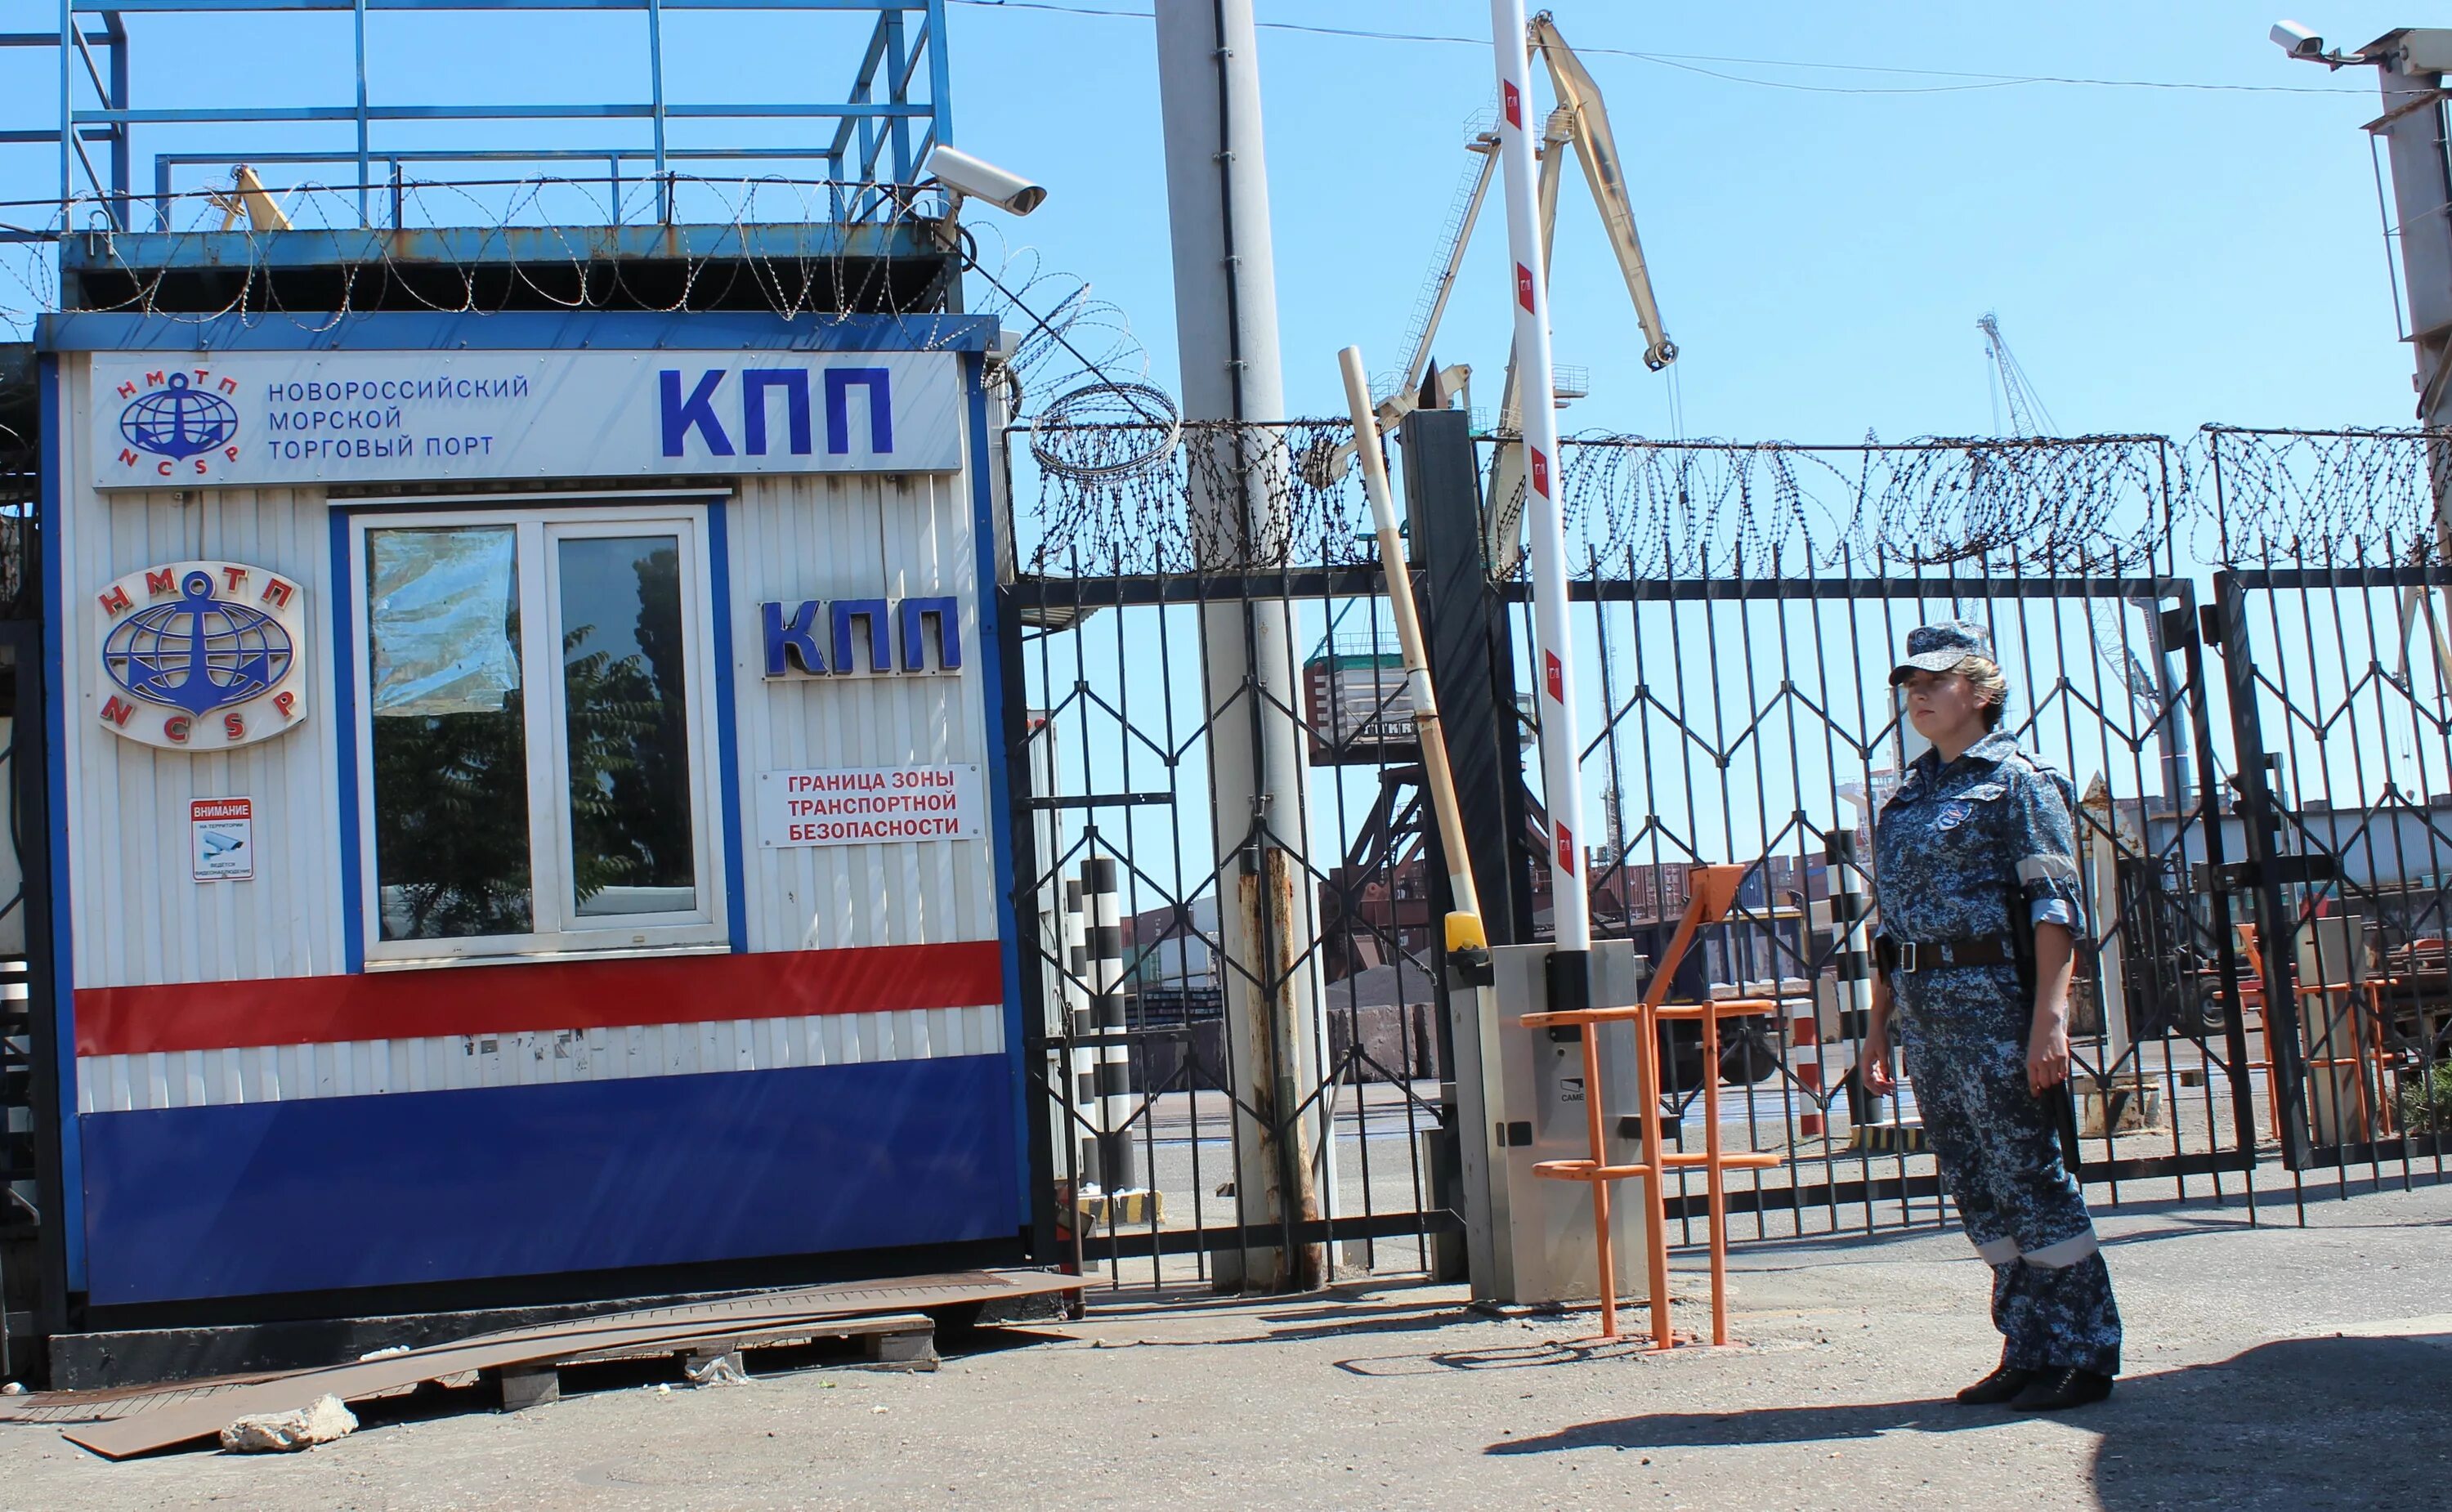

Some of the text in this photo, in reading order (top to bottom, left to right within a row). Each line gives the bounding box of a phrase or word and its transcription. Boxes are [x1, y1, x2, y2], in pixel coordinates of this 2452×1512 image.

[117, 369, 238, 399] НМТП
[268, 375, 529, 402] НОВОРОССИЙСКИЙ
[268, 405, 401, 432] МОРСКОЙ
[660, 368, 893, 457] КПП
[268, 434, 494, 460] ТОРГОВЫЙ ПОРТ
[117, 446, 239, 476] NCSP
[98, 566, 294, 615] НМТП
[761, 596, 963, 677] КПП
[101, 691, 297, 743] NCSP
[788, 771, 955, 793] ГРАНИЦА ЗОНЫ
[194, 804, 249, 817] ВНИМАНИЕ
[788, 790, 957, 816] ТРАНСПОРТНОЙ
[789, 817, 960, 841] БЕЗОПАСНОСТИ
[1561, 1093, 1585, 1102] CAME
